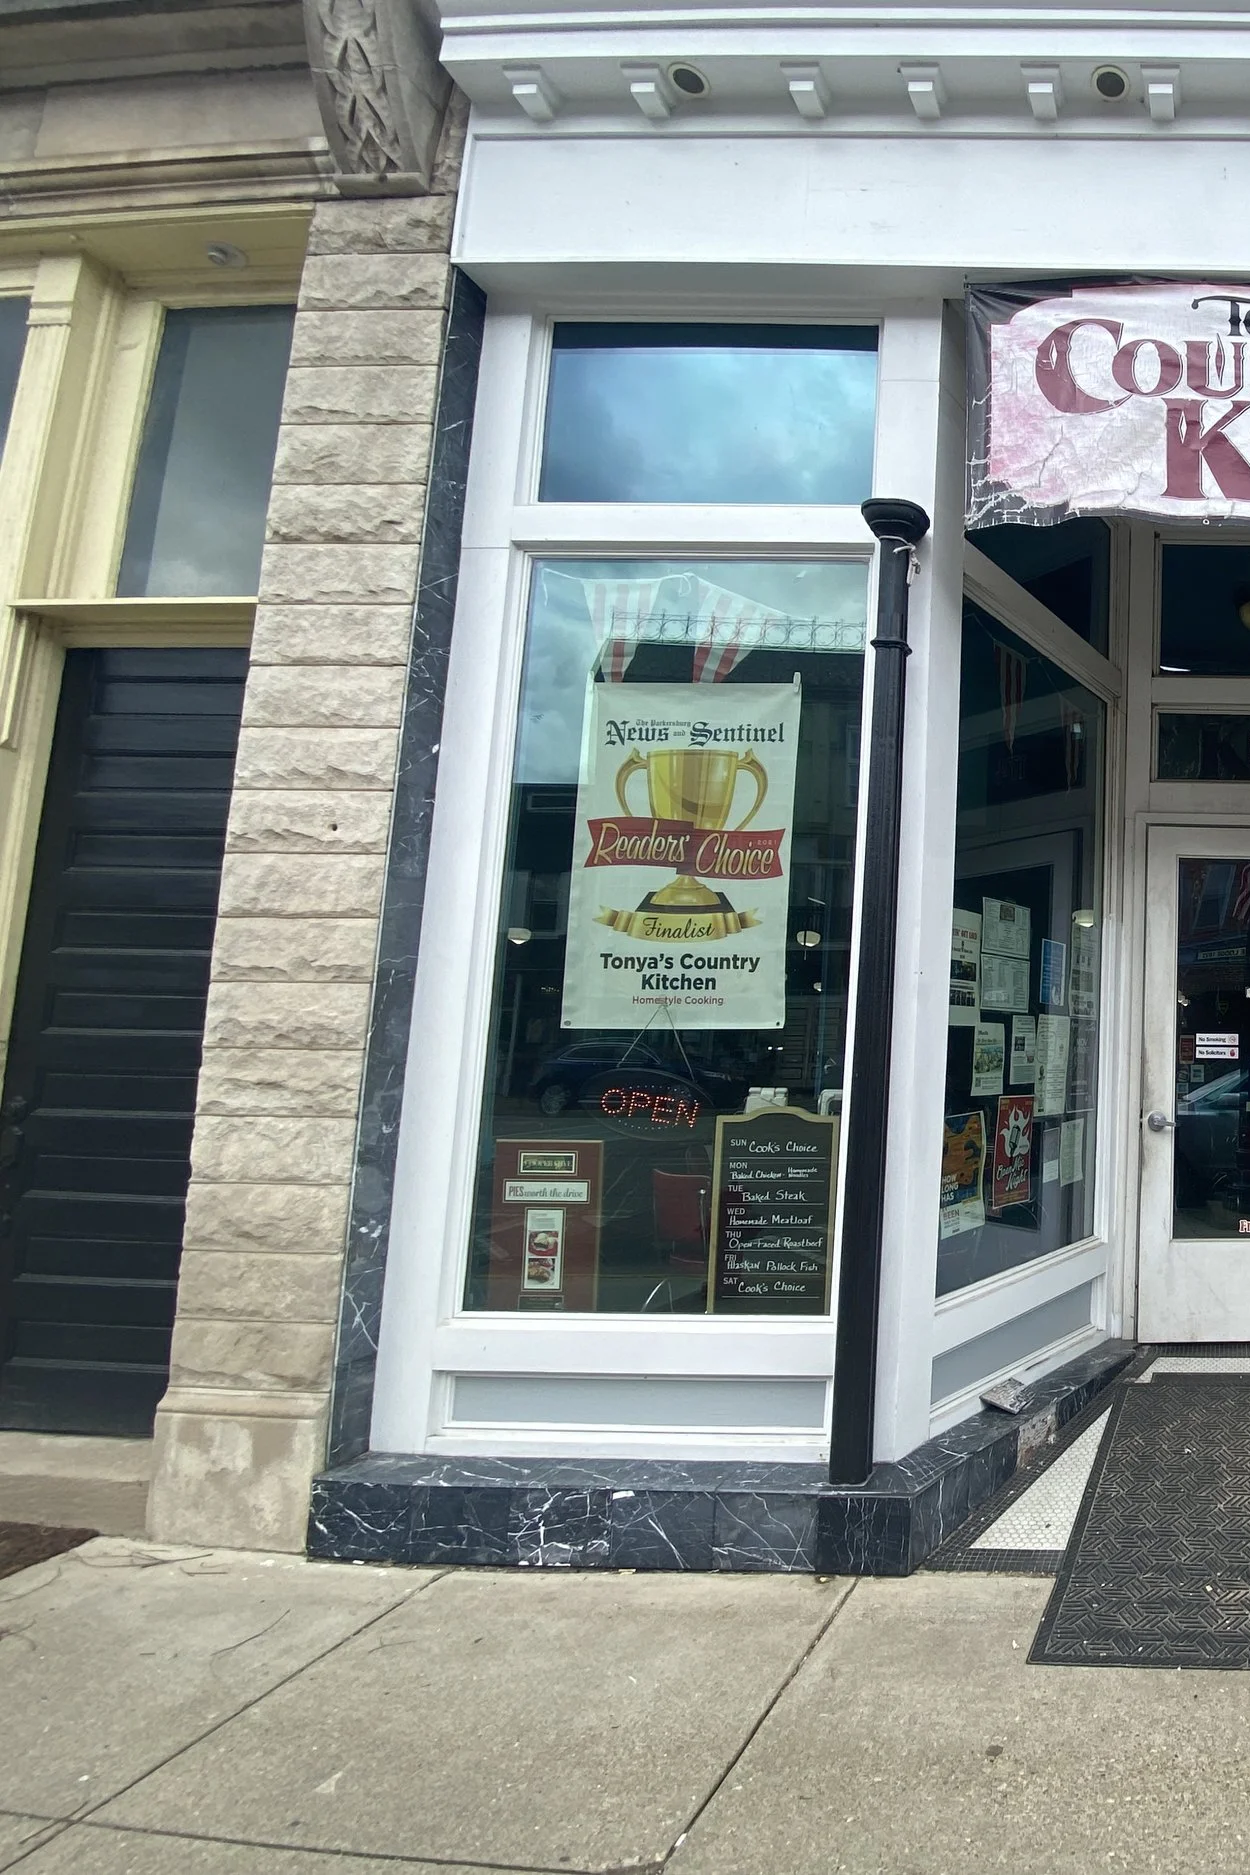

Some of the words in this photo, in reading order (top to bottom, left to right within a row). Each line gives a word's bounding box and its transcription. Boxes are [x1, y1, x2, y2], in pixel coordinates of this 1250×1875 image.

[635, 719, 648, 727] The
[651, 719, 691, 728] Parkersburg
[605, 719, 669, 746] News
[673, 729, 686, 737] and
[688, 721, 785, 747] Sentinel
[695, 832, 775, 876] Choice
[642, 917, 715, 939] Finalist
[600, 953, 674, 972] Tonya's
[680, 953, 761, 973] Country
[641, 973, 717, 990] Kitchen
[684, 995, 724, 1006] Cooking
[601, 1089, 699, 1128] OPEN
[749, 1141, 780, 1153] Cook's
[786, 1141, 818, 1153] Choice
[942, 1174, 957, 1183] HOW
[508, 1185, 524, 1197] PIES
[524, 1187, 547, 1197] worth
[549, 1187, 562, 1197] the
[563, 1188, 583, 1198] drive
[941, 1182, 959, 1193] LONG
[741, 1191, 770, 1202] Baked
[775, 1189, 808, 1201] Steak
[941, 1192, 955, 1201] HAS
[729, 1216, 768, 1225] Homemade
[771, 1215, 813, 1224] Meatloaf
[943, 1208, 960, 1220] BEEN
[766, 1261, 797, 1272] Pollock
[800, 1261, 818, 1271] Fish
[723, 1277, 738, 1285] SAT
[738, 1282, 768, 1294] Cook's
[774, 1281, 806, 1292] Choice
